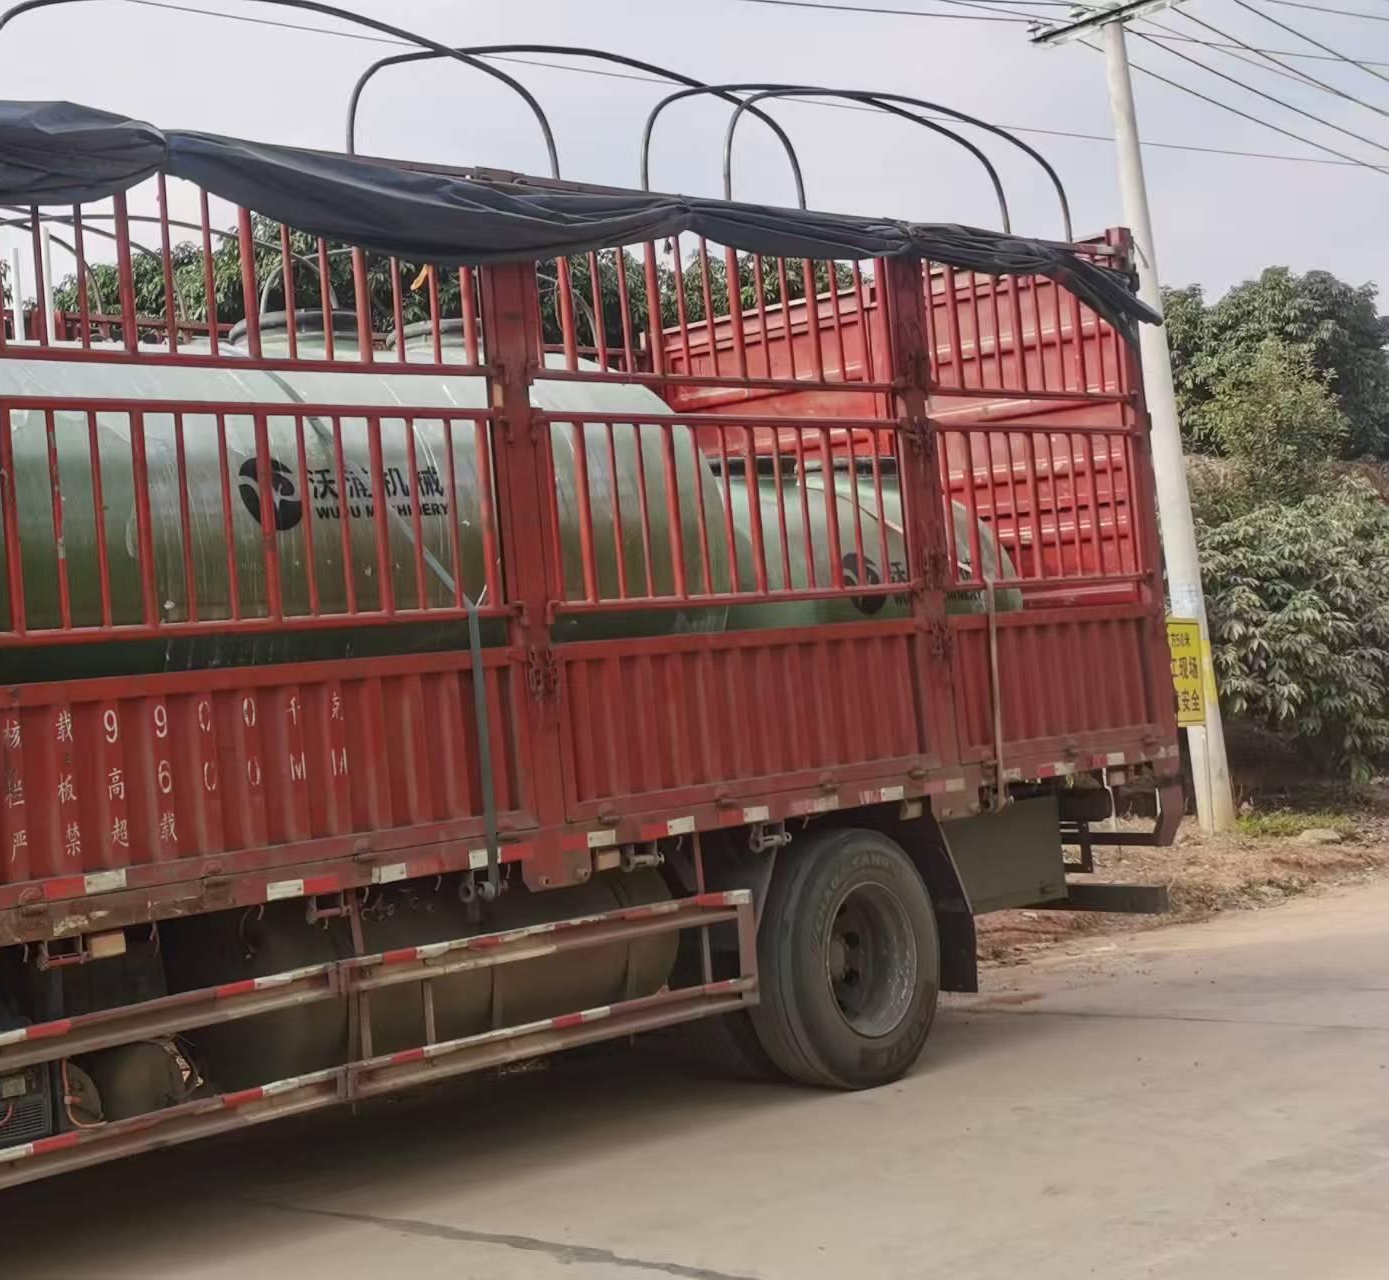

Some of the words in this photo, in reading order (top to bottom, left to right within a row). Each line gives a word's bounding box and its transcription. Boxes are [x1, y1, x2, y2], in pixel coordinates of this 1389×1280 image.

[315, 504, 362, 519] WUU
[1177, 688, 1201, 712] 安全
[11, 811, 178, 864] 严禁超载
